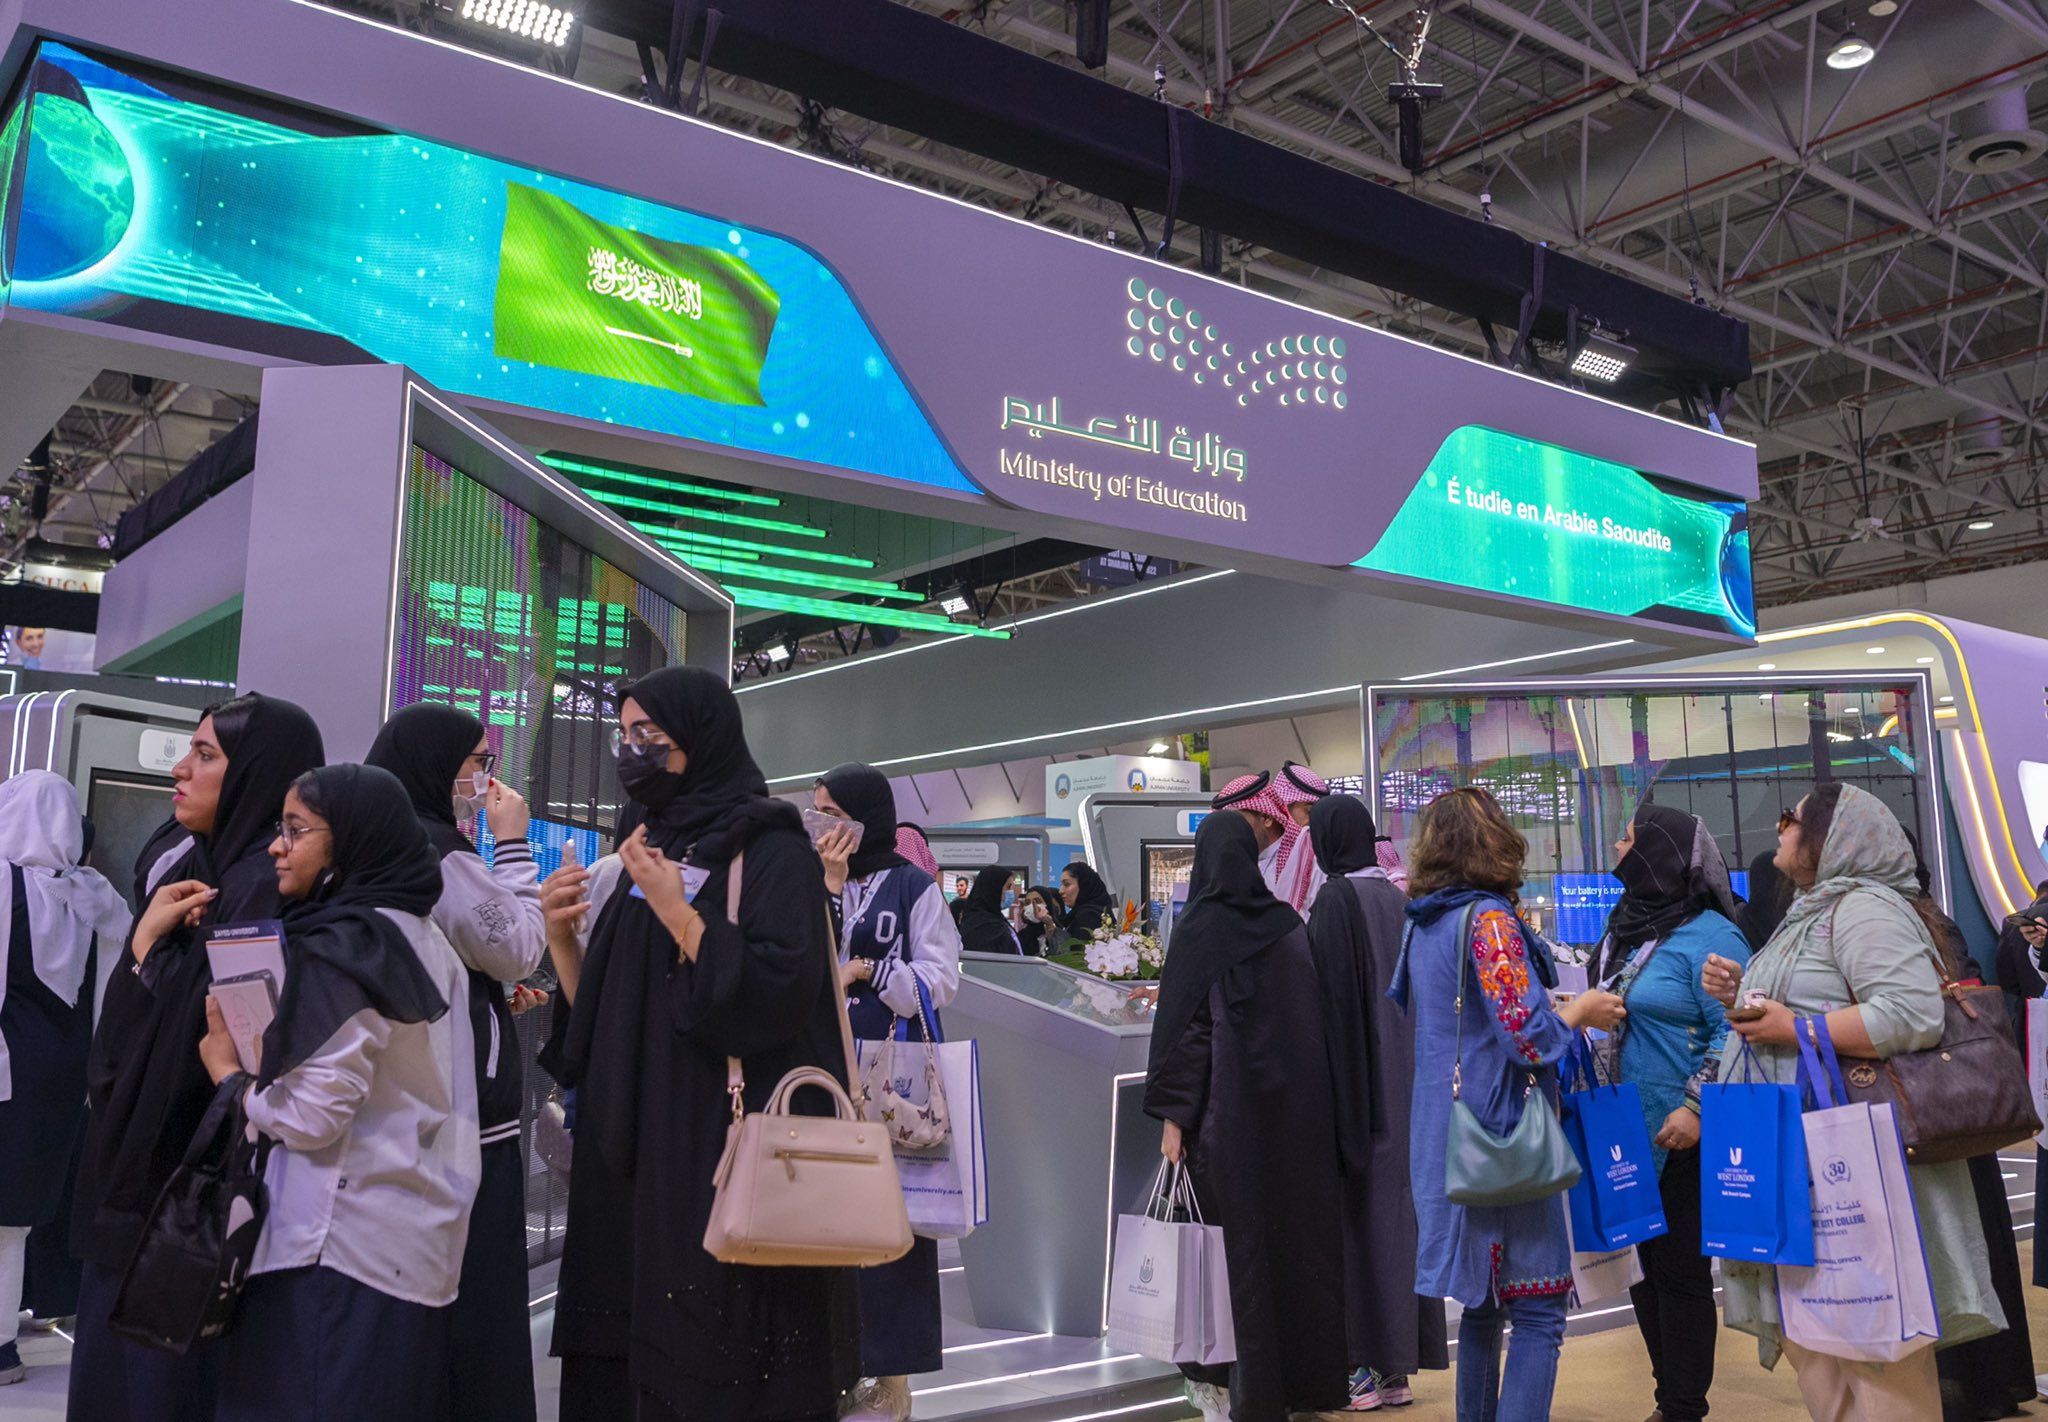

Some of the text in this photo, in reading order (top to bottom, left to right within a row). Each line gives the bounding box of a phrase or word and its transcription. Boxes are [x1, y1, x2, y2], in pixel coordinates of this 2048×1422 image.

[1001, 396, 1248, 481] وزارة التعليم
[1000, 448, 1248, 522] Ministry of Education
[1465, 486, 1512, 516] tudie
[1516, 501, 1538, 521] en
[1544, 506, 1598, 535] Arabie
[1602, 517, 1672, 552] Saoudite
[1561, 885, 1577, 896] Your
[1577, 884, 1602, 898] battery
[1733, 1173, 1756, 1182] LONDON
[1835, 1212, 1866, 1227] COLLEGE
